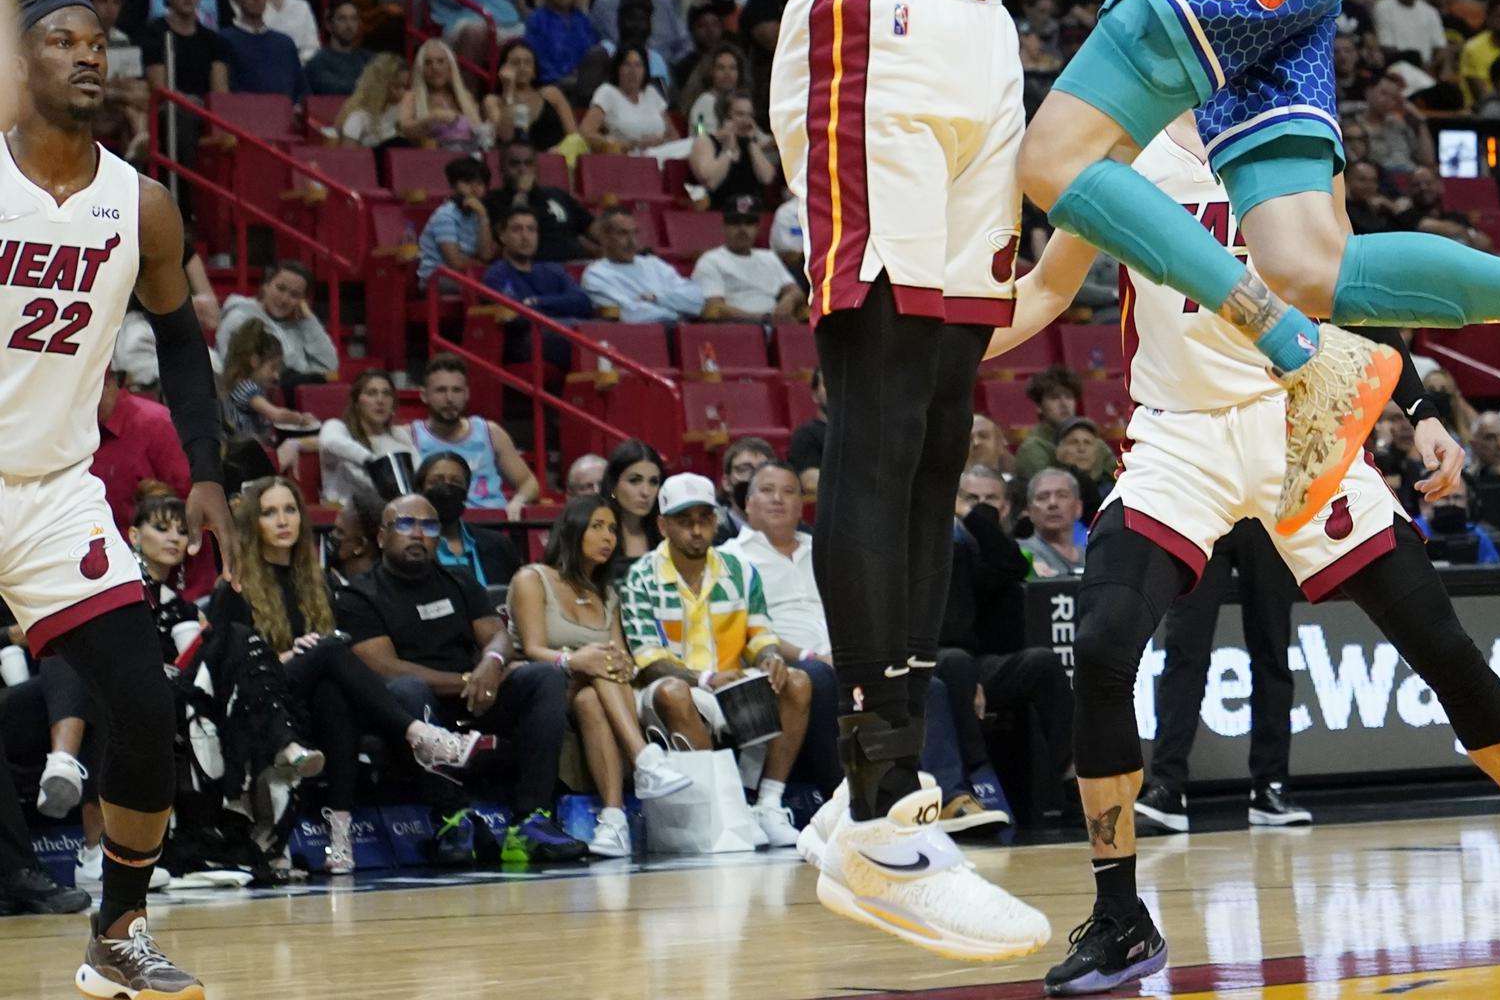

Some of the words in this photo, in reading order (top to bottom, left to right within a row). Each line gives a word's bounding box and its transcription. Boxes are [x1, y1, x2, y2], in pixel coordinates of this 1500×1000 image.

[7, 297, 93, 356] 22
[1051, 594, 1075, 690] REF
[392, 820, 425, 836] ONE
